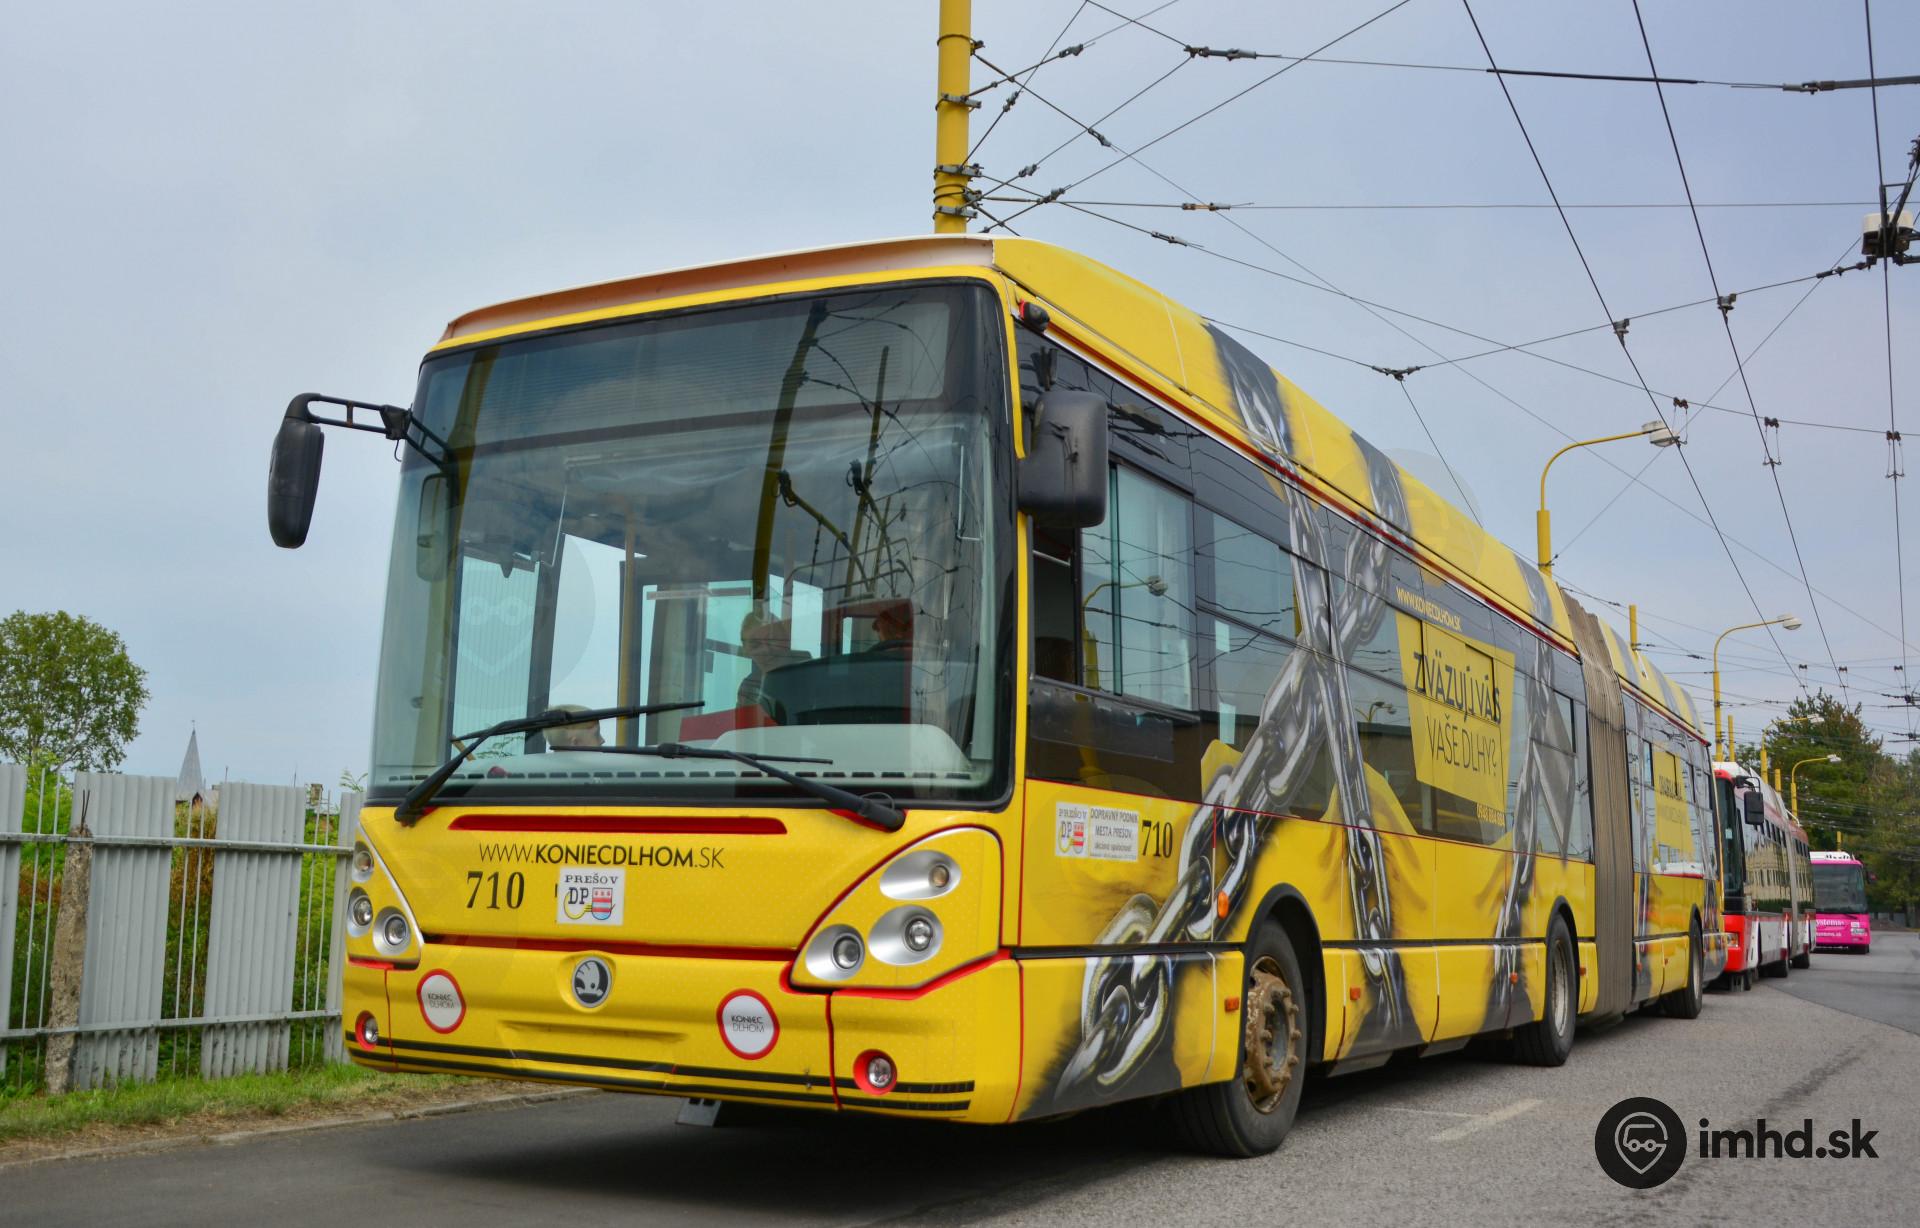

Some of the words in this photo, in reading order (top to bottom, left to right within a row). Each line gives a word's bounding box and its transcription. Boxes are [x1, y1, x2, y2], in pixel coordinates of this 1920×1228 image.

[1474, 674, 1501, 724] VÁS
[1426, 713, 1460, 767] VAŠE
[1461, 729, 1497, 777] DLHY?
[1061, 820, 1072, 838] DP
[1095, 824, 1112, 838] MESTA
[1142, 819, 1173, 858] 710
[479, 843, 724, 869] WWW.KONIECDLHOM.SK
[564, 872, 619, 884] PREŠOV
[466, 871, 525, 909] 710
[567, 887, 590, 905] DP
[730, 1014, 764, 1024] KONIEC
[732, 1022, 765, 1033] DLHOM
